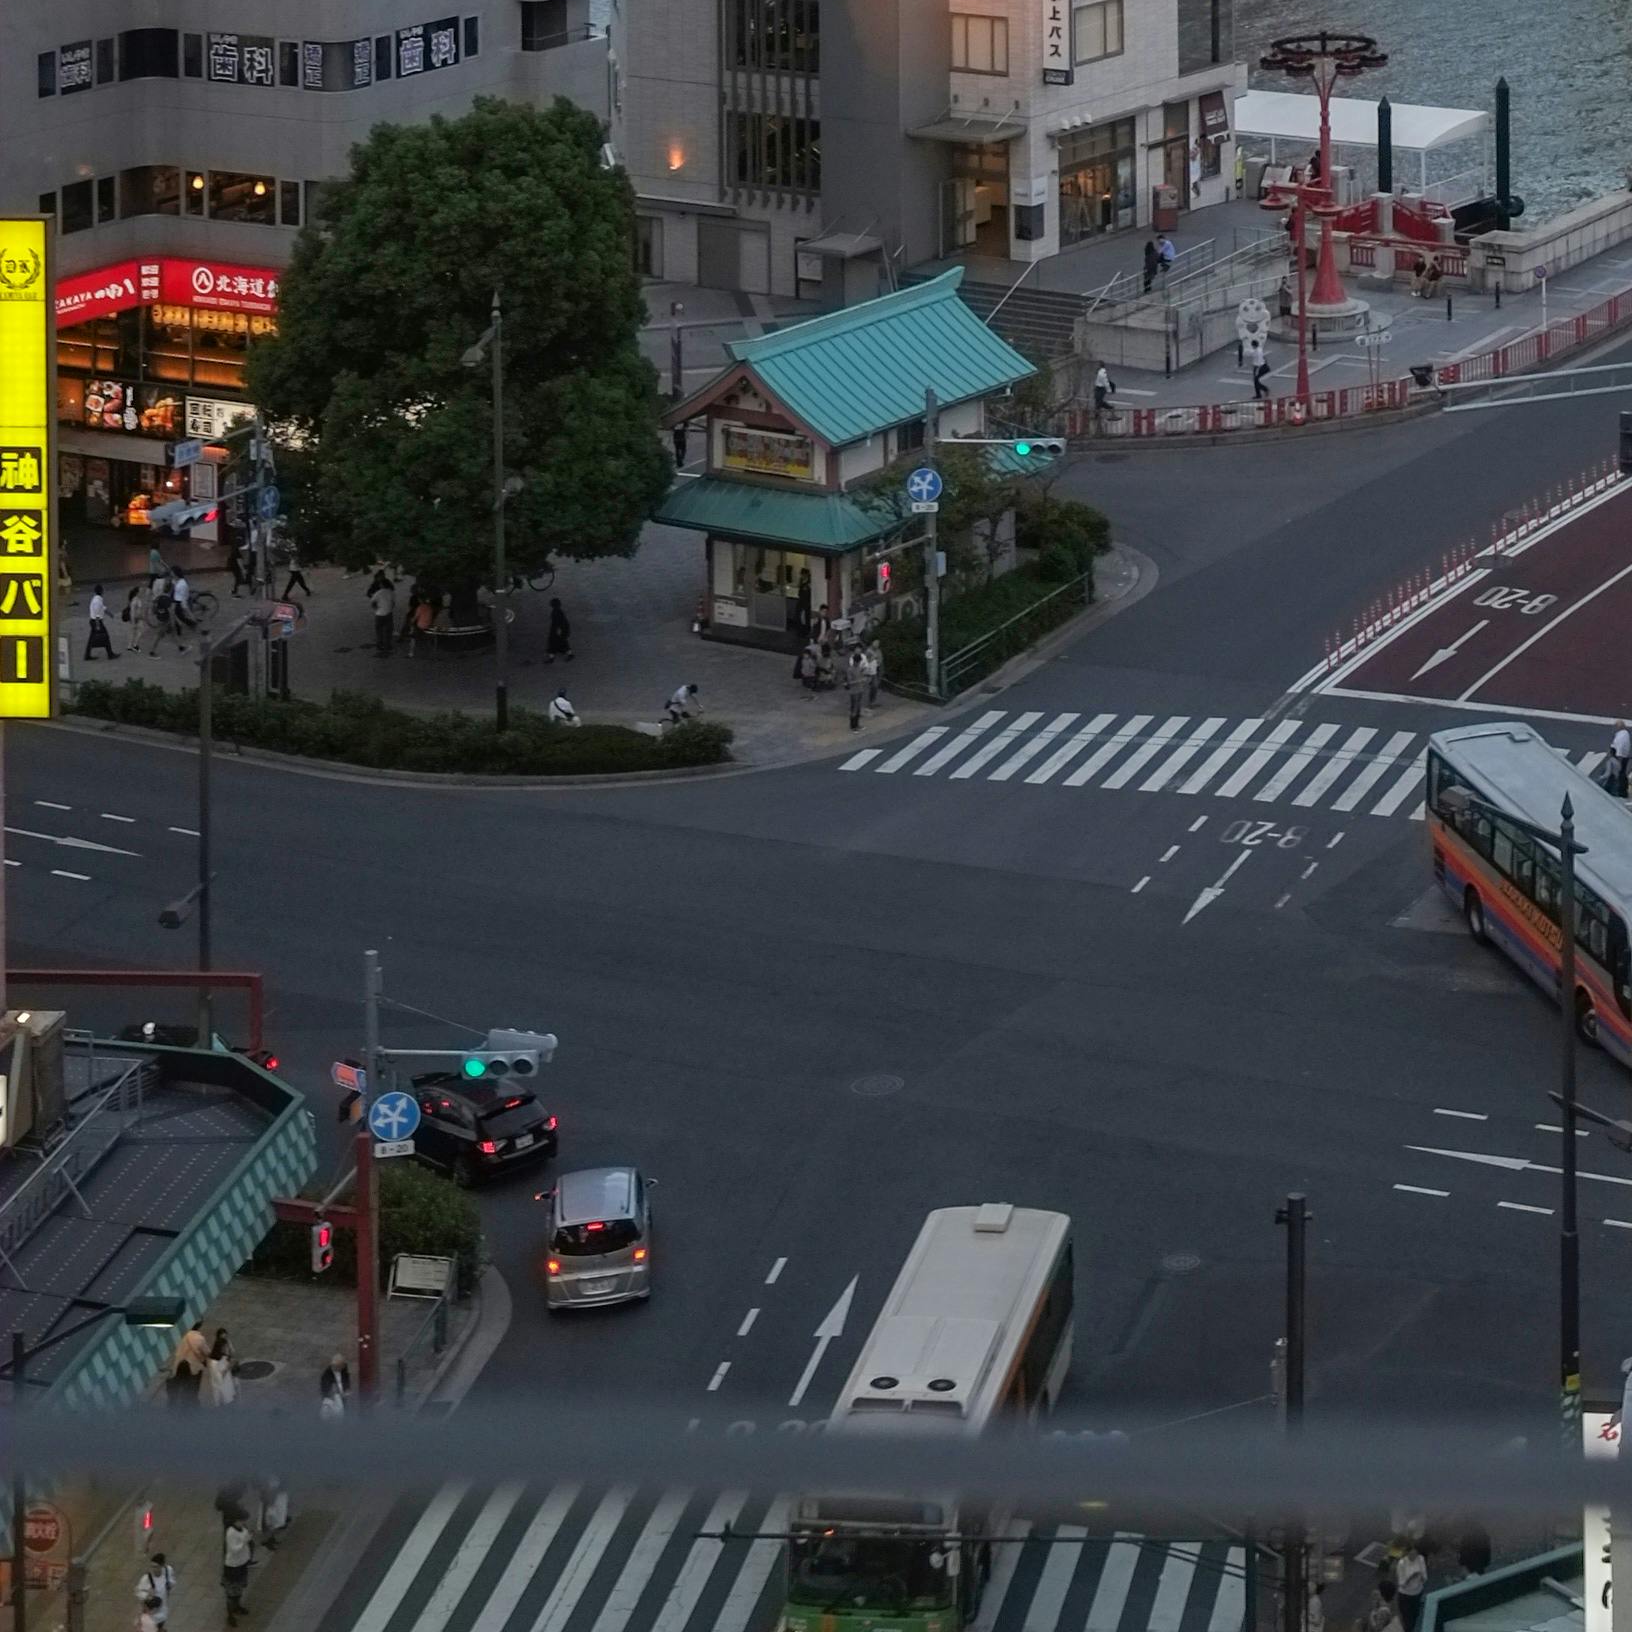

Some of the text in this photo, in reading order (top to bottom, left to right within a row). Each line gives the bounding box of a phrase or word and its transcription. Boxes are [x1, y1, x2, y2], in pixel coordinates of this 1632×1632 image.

[210, 44, 273, 84] 歯科
[401, 27, 456, 77] 歯科
[0, 452, 41, 680] 神谷バー
[1472, 586, 1558, 614] 8-20
[1220, 819, 1310, 848] 8-20
